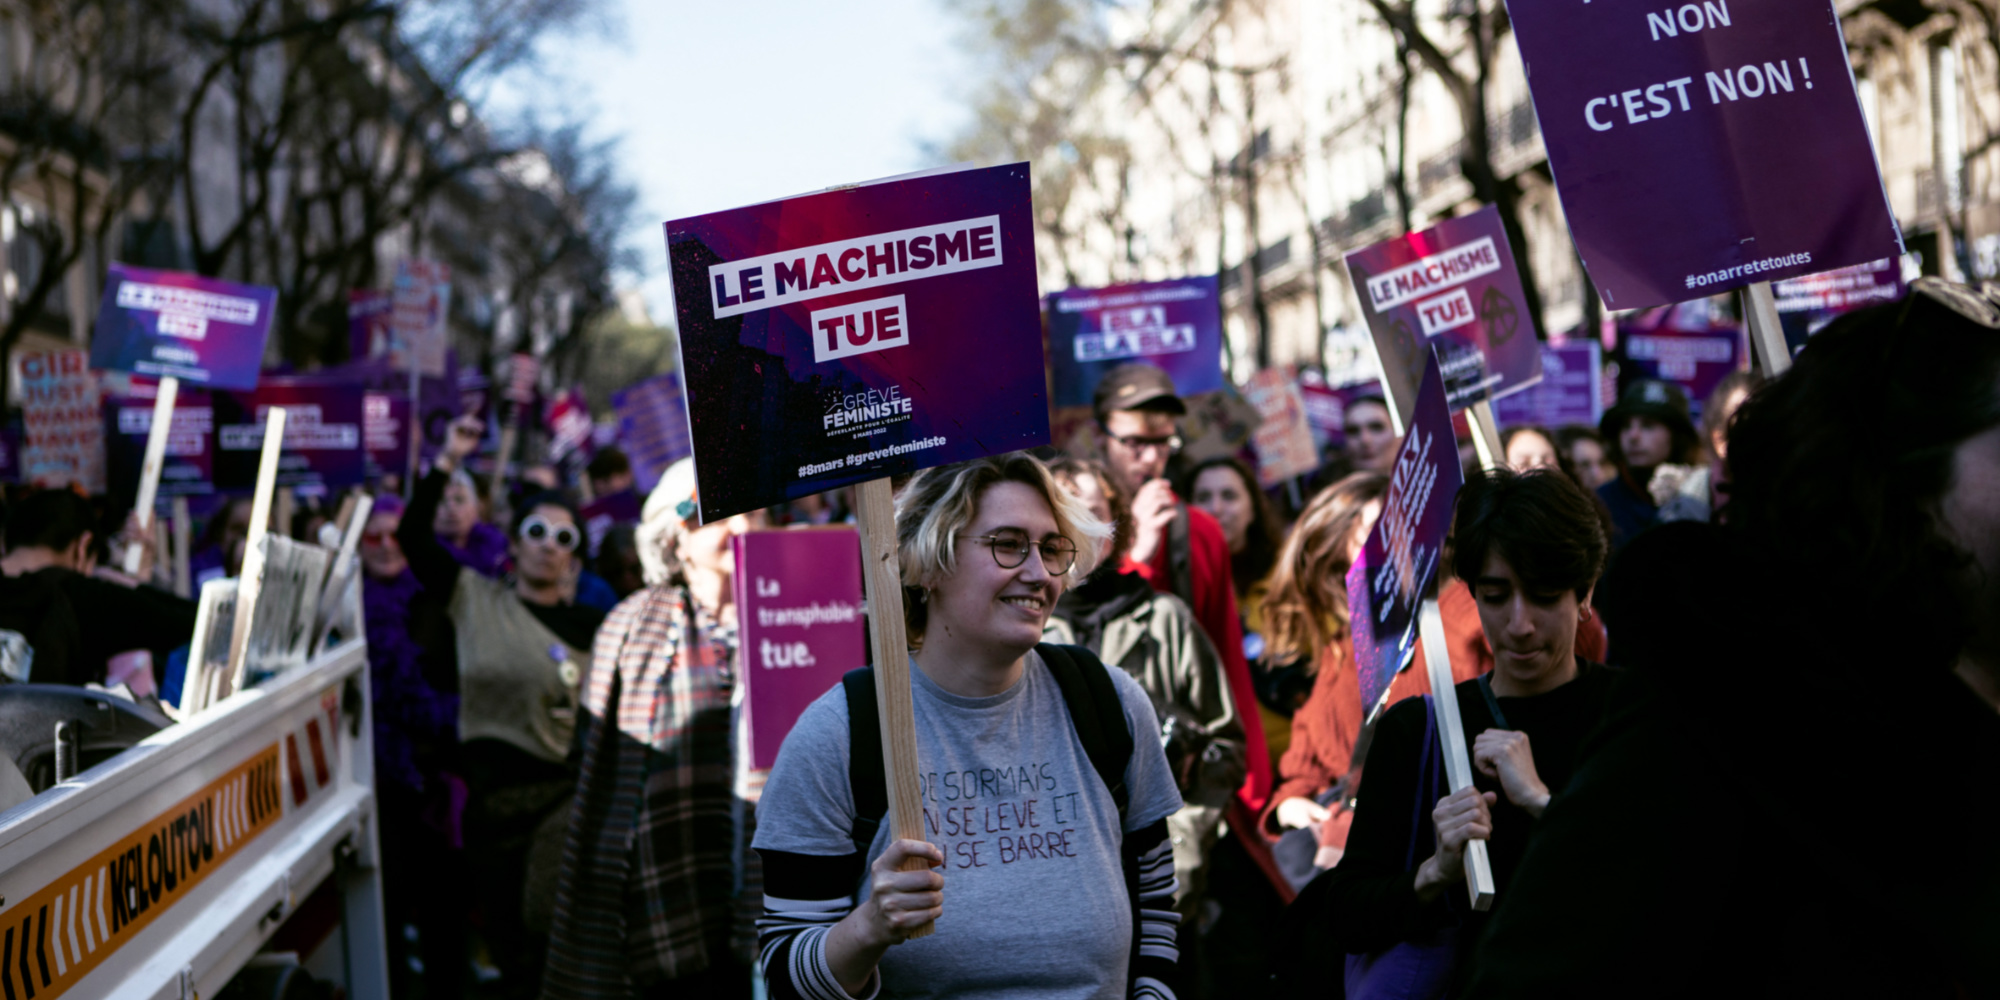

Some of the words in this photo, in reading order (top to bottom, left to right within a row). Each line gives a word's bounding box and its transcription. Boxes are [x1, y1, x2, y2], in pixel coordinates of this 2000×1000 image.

[1647, 0, 1731, 41] NON
[1584, 76, 1692, 132] C'EST
[1705, 60, 1795, 104] NON
[714, 266, 766, 309] LE
[774, 225, 996, 296] MACHISME
[1371, 280, 1394, 304] LE
[1394, 244, 1495, 296] MACHISME
[1685, 251, 1812, 289] #onarretetoutes
[818, 305, 902, 351] TUE
[1423, 297, 1469, 327] TUE
[823, 397, 912, 430] FÉMINISTE
[844, 385, 900, 410] GRÈVE
[827, 424, 863, 437] DÉFERLANTE
[864, 421, 880, 429] POUR
[857, 430, 873, 438] MARS
[873, 427, 887, 435] 2022
[798, 458, 844, 478] #8mars
[846, 436, 946, 466] #grevefeministe
[757, 577, 780, 597] La
[759, 600, 855, 628] transphobie
[761, 639, 816, 669] tue.
[946, 806, 977, 837] SE
[985, 800, 1040, 833] LEVE
[1053, 792, 1079, 824] ET
[956, 841, 988, 869] SE
[999, 829, 1077, 864] BARRE
